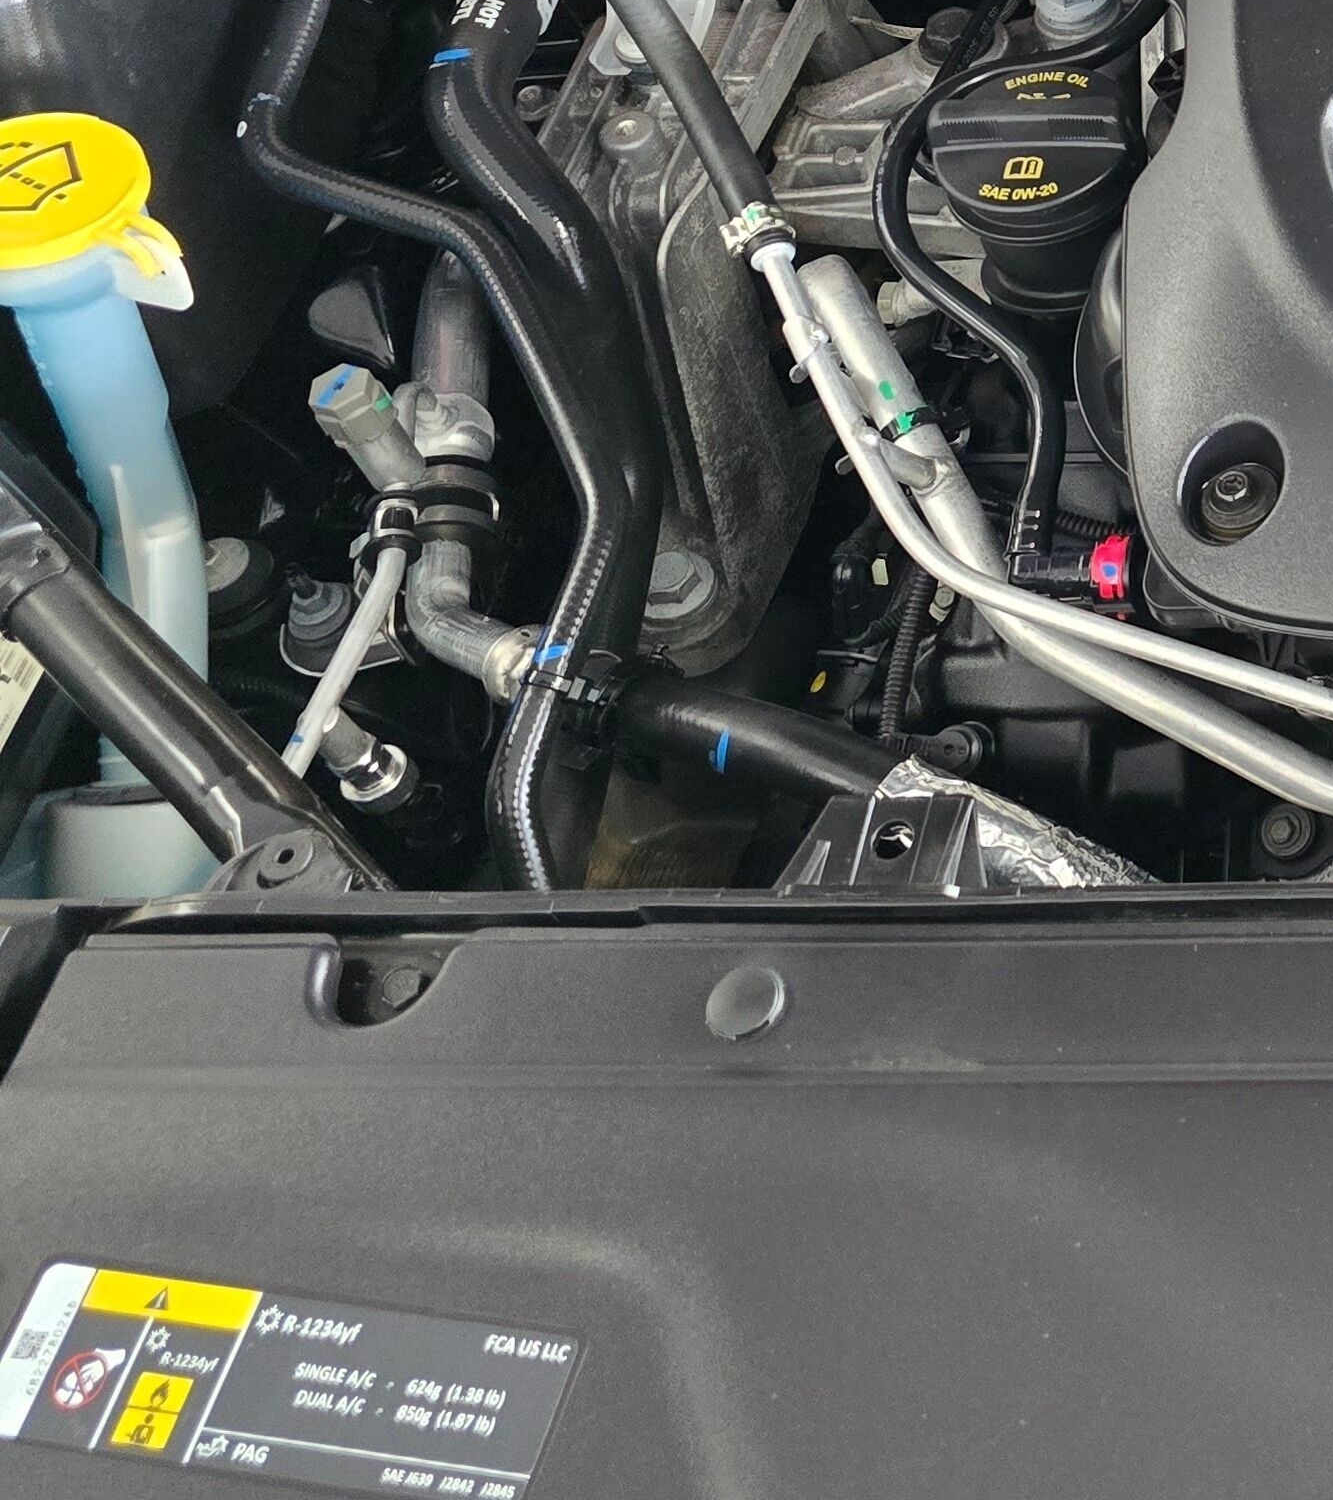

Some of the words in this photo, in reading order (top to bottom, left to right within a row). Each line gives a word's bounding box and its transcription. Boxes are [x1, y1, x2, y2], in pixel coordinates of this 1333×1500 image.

[1004, 71, 1066, 90] ENGINE
[1069, 73, 1090, 88] OIL
[978, 183, 1010, 201] SAE
[1011, 181, 1059, 201] 0W-20
[281, 1315, 362, 1346] R-1234yf
[484, 1334, 515, 1355] FCA
[517, 1338, 541, 1358] US
[541, 1343, 571, 1363] LLC
[159, 1351, 219, 1374] R-1234yf
[293, 1363, 345, 1383] SINGLE
[346, 1370, 377, 1389] A/C
[405, 1379, 443, 1402] 624g
[444, 1383, 484, 1405] (1.38
[483, 1389, 507, 1412] lb)
[293, 1390, 334, 1409] DUAL
[336, 1397, 367, 1417] A/C
[395, 1405, 433, 1430] 850g
[434, 1409, 474, 1430] (1.87
[473, 1416, 496, 1437] lb)
[231, 1443, 269, 1466] PAG
[380, 1467, 404, 1485] SAE
